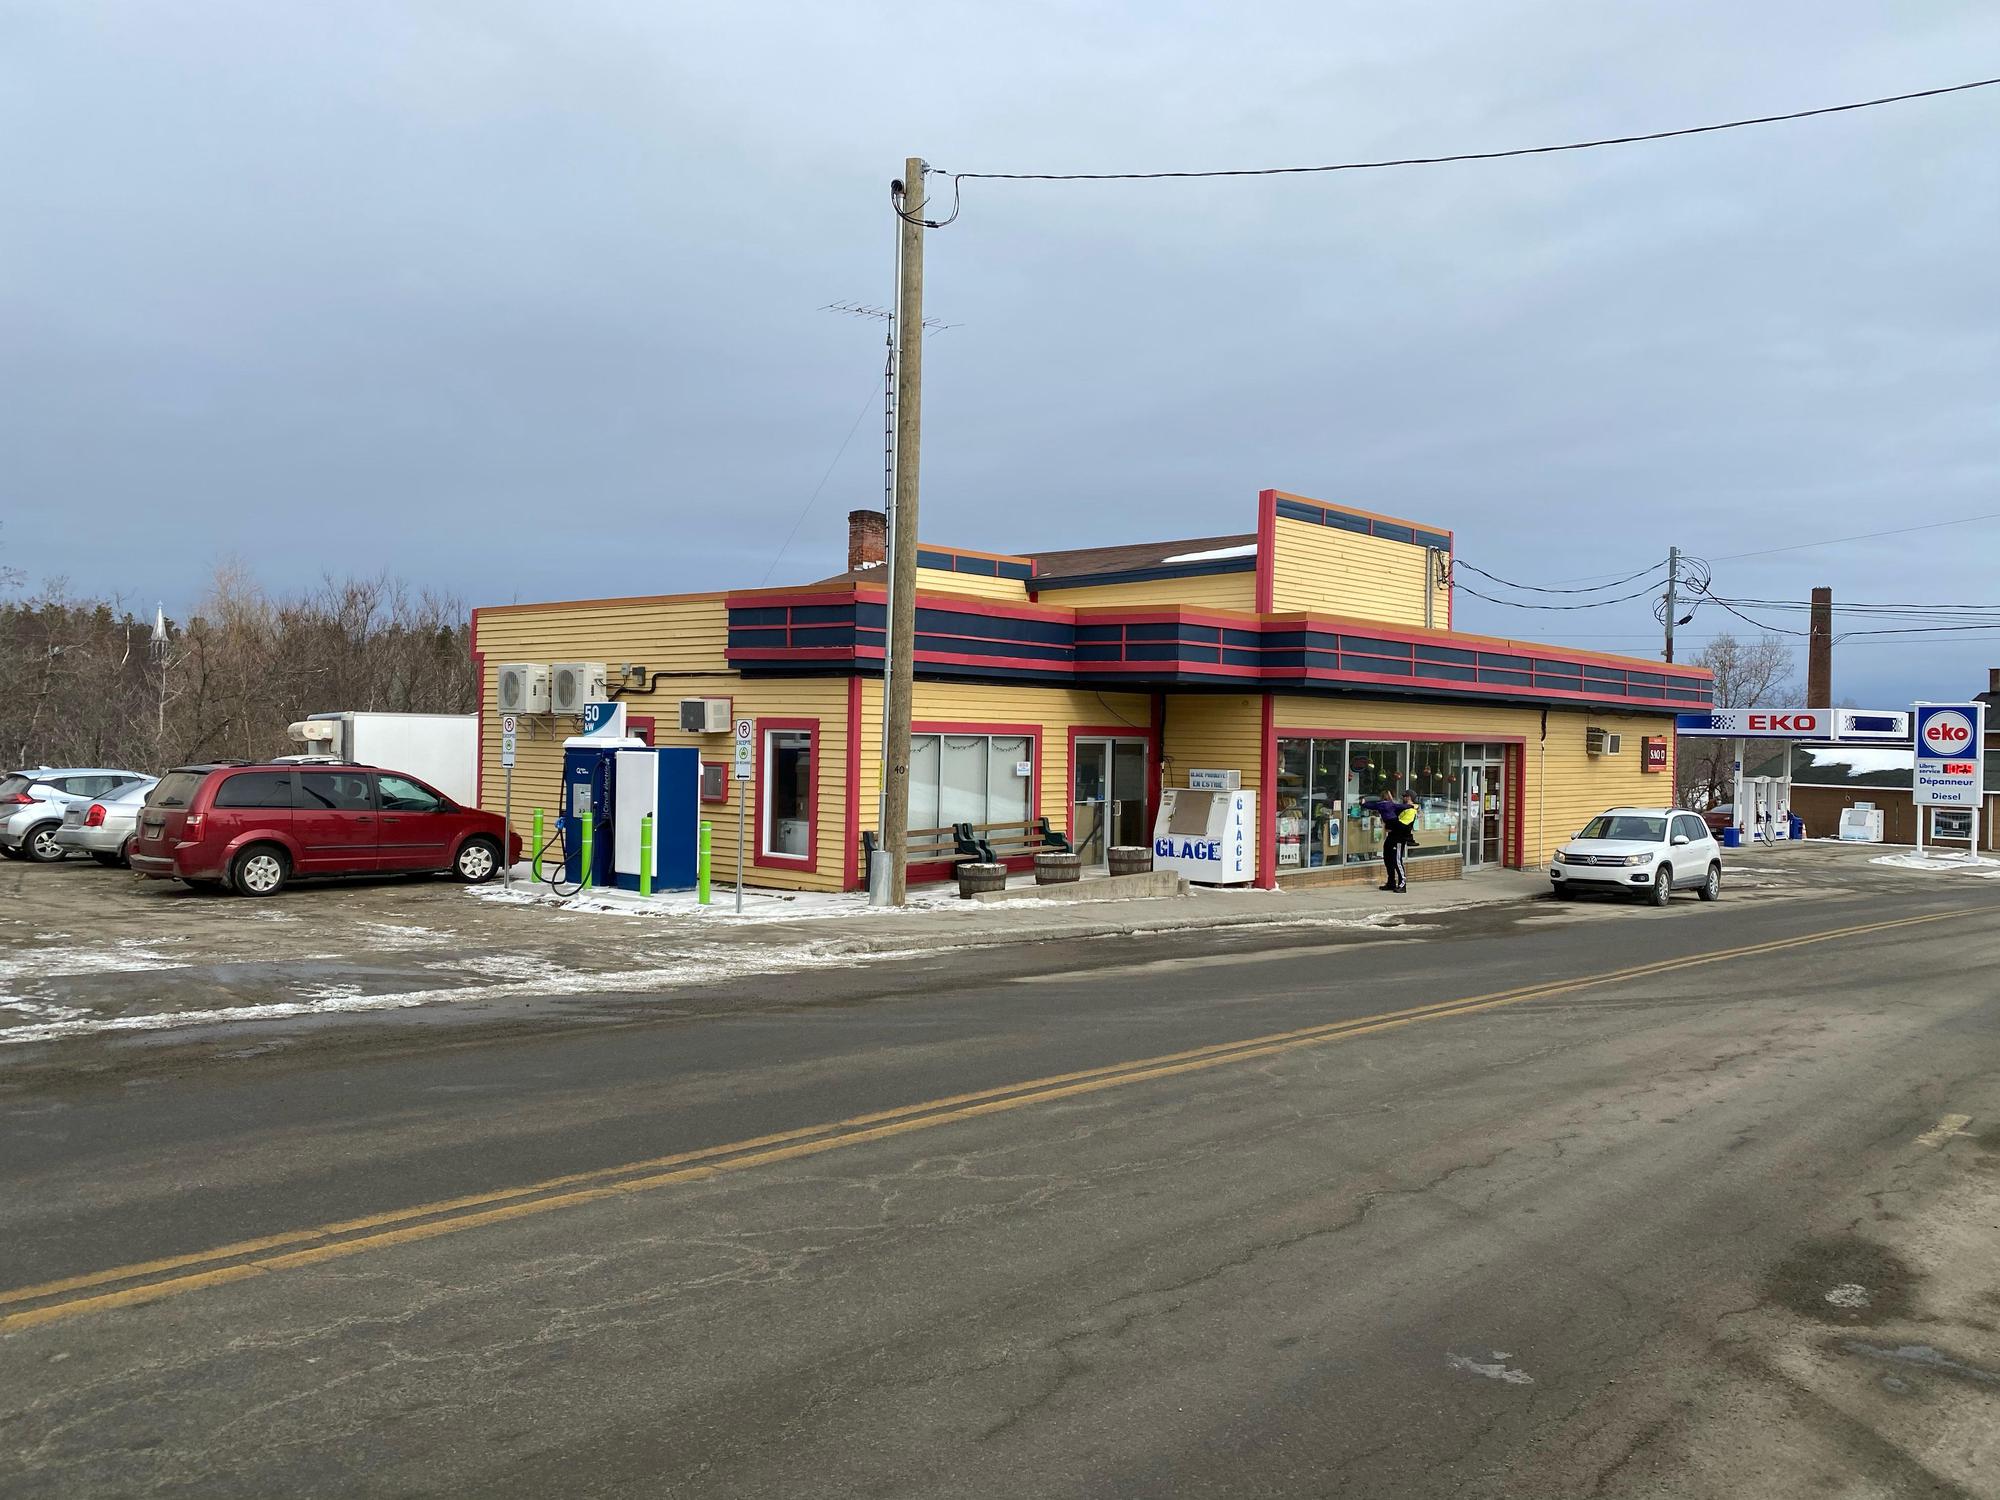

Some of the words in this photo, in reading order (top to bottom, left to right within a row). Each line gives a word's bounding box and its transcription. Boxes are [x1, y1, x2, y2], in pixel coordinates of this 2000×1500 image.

[585, 705, 599, 721] 50
[585, 723, 595, 731] kW
[1748, 715, 1816, 731] EKO
[1927, 723, 1968, 740] eko
[894, 765, 905, 775] 40
[1920, 776, 1974, 786] Dépanneur
[1932, 792, 1961, 800] Diesel
[1155, 838, 1222, 861] GLACE
